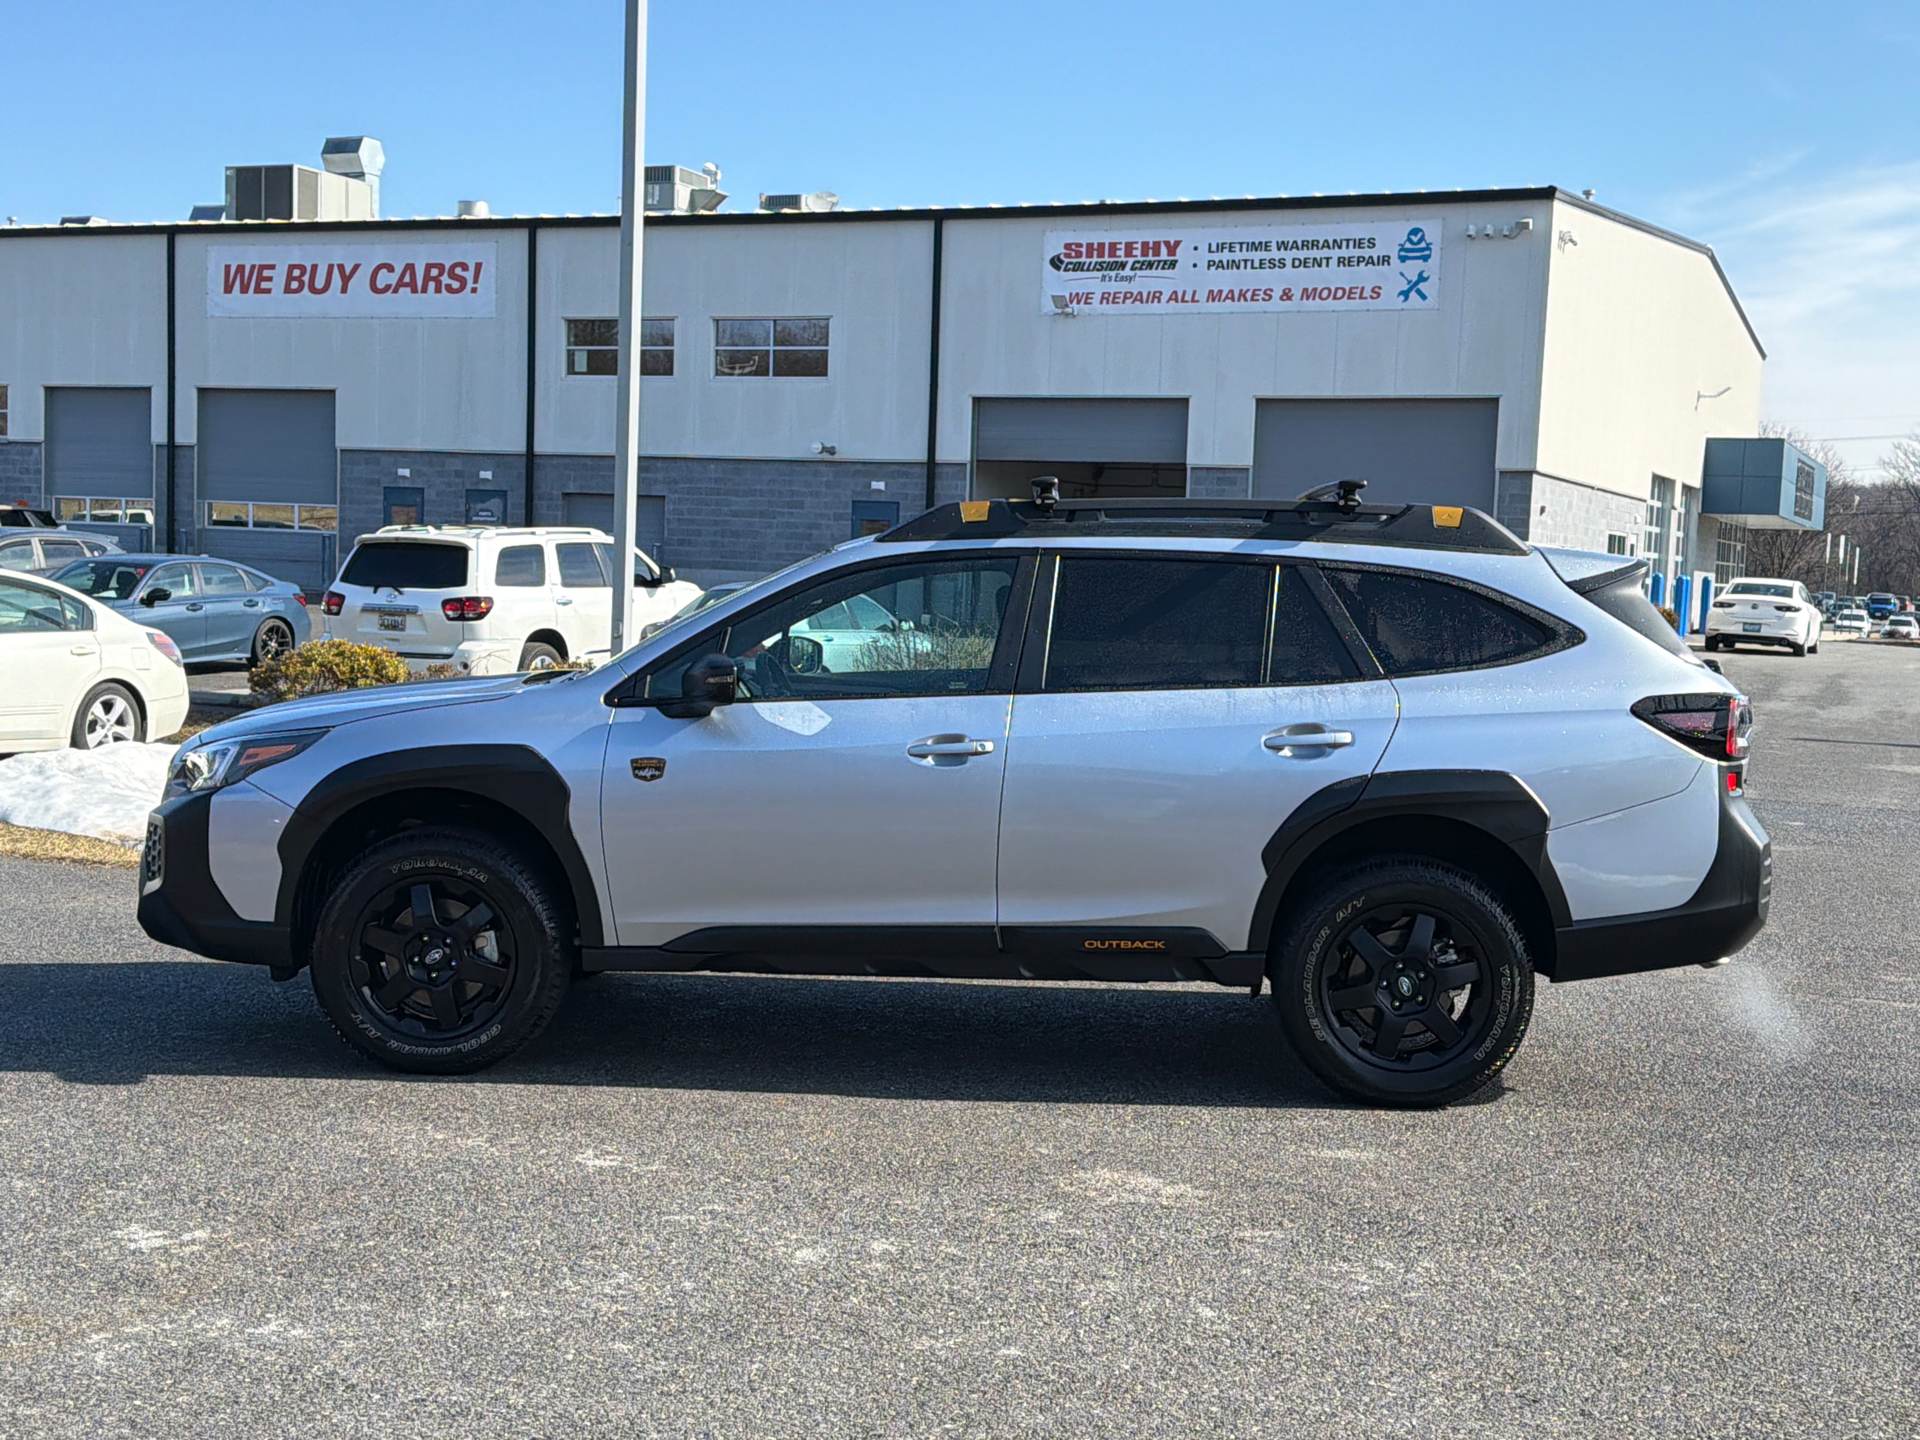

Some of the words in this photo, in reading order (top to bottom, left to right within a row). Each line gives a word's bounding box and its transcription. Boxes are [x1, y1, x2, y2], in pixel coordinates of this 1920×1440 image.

[1063, 240, 1183, 259] SHEEHY
[1208, 240, 1272, 253] LIFETIME
[1276, 237, 1376, 251] WARRANTIES
[1062, 260, 1126, 272] COLLISION
[1129, 259, 1179, 271] CENTER
[1206, 257, 1286, 271] PAINTLESS
[1291, 256, 1332, 269] DENT
[1336, 255, 1391, 268] REPAIR
[223, 263, 276, 294] WE
[283, 263, 362, 295] BUY
[369, 262, 483, 295] CARS!
[1100, 273, 1113, 283] It's
[1114, 272, 1137, 284] Easy!
[1068, 292, 1095, 305] WE
[1099, 290, 1163, 304] REPAIR
[1166, 290, 1200, 304] ALL
[1205, 288, 1274, 303] MAKES
[1279, 287, 1294, 301] &
[1300, 285, 1382, 301] MODELS
[1084, 940, 1166, 949] OUTBACK
[1473, 964, 1512, 1061] YOKOHAMA
